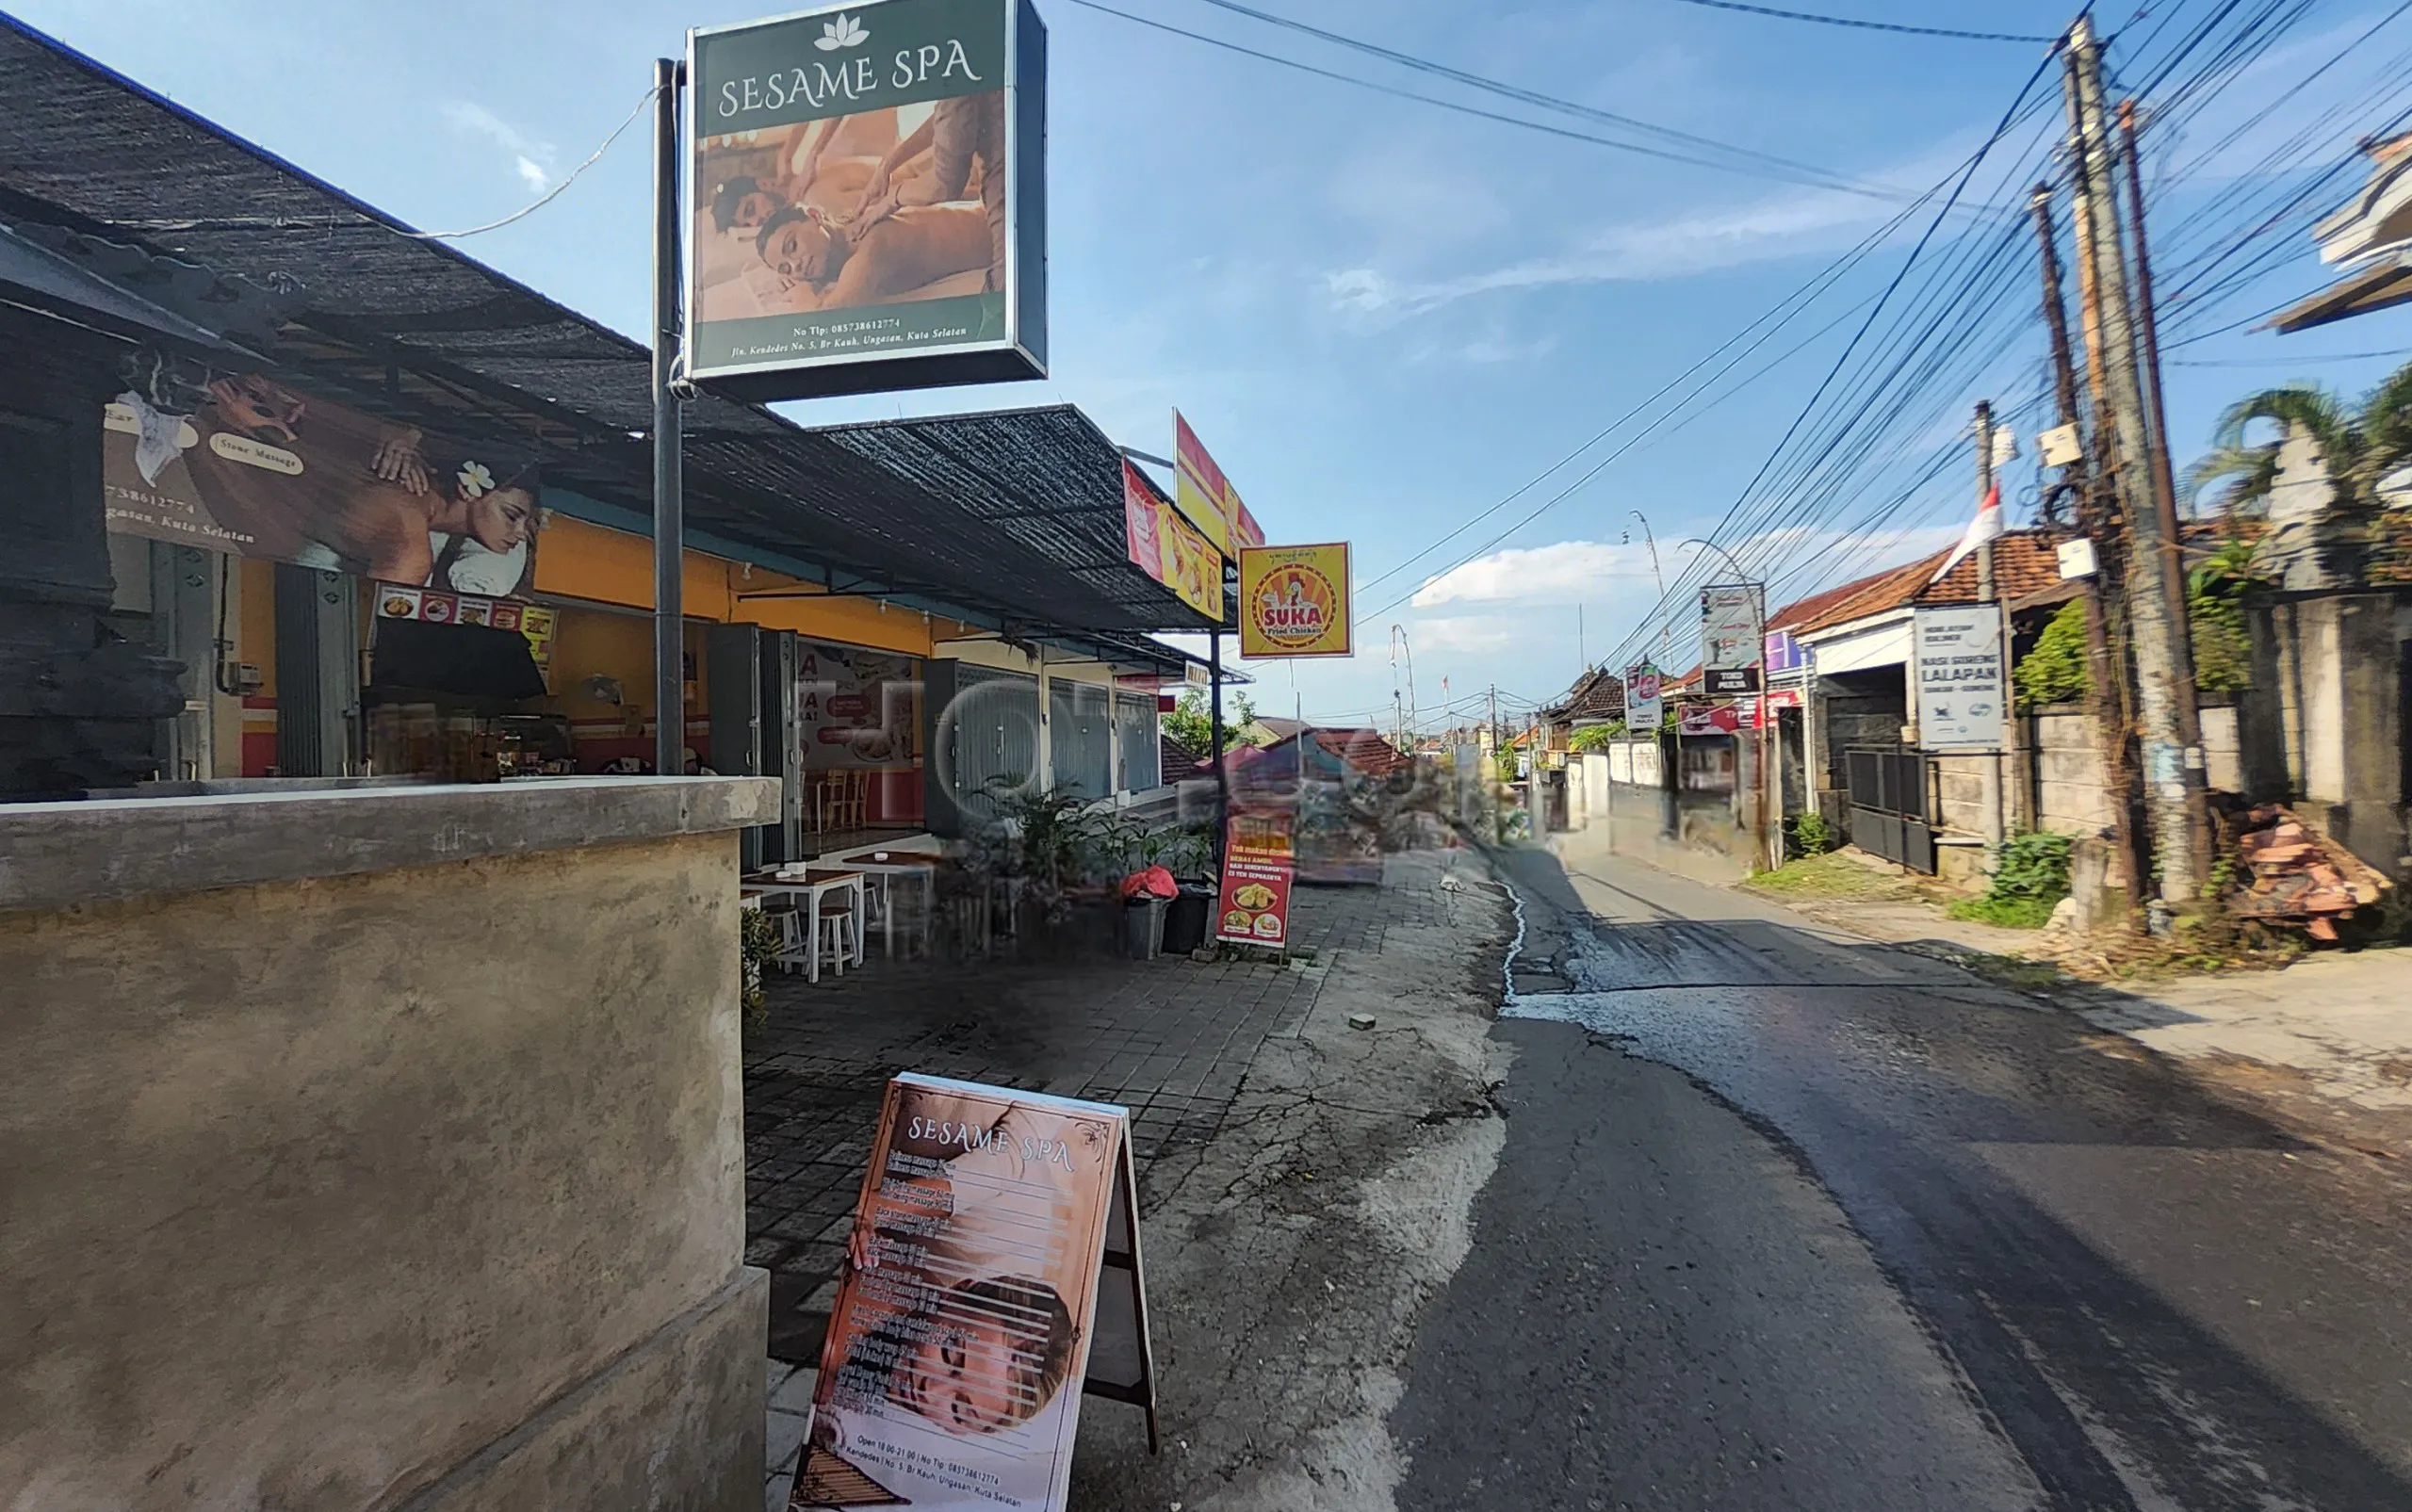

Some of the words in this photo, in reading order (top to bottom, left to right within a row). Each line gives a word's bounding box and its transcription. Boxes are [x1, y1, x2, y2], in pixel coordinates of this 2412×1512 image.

[718, 57, 879, 117] SESAME
[891, 40, 982, 89] SPA
[793, 327, 807, 337] No
[831, 318, 901, 333] 085738612774
[749, 343, 788, 355] Kendedes
[820, 339, 831, 349] Br
[907, 330, 929, 341] Kuta
[932, 327, 967, 338] Selatan
[220, 438, 251, 455] Stone
[255, 447, 297, 469] Massage
[160, 515, 197, 533] Kuta
[203, 523, 255, 545] Selatan
[1263, 608, 1323, 626] SUKA
[1290, 626, 1322, 635] Chicken
[908, 1115, 1008, 1156] SESAME
[1019, 1135, 1075, 1173] SPA
[857, 1435, 876, 1447] Open
[974, 1485, 992, 1499] Kuta
[994, 1491, 1022, 1508] Selatan
